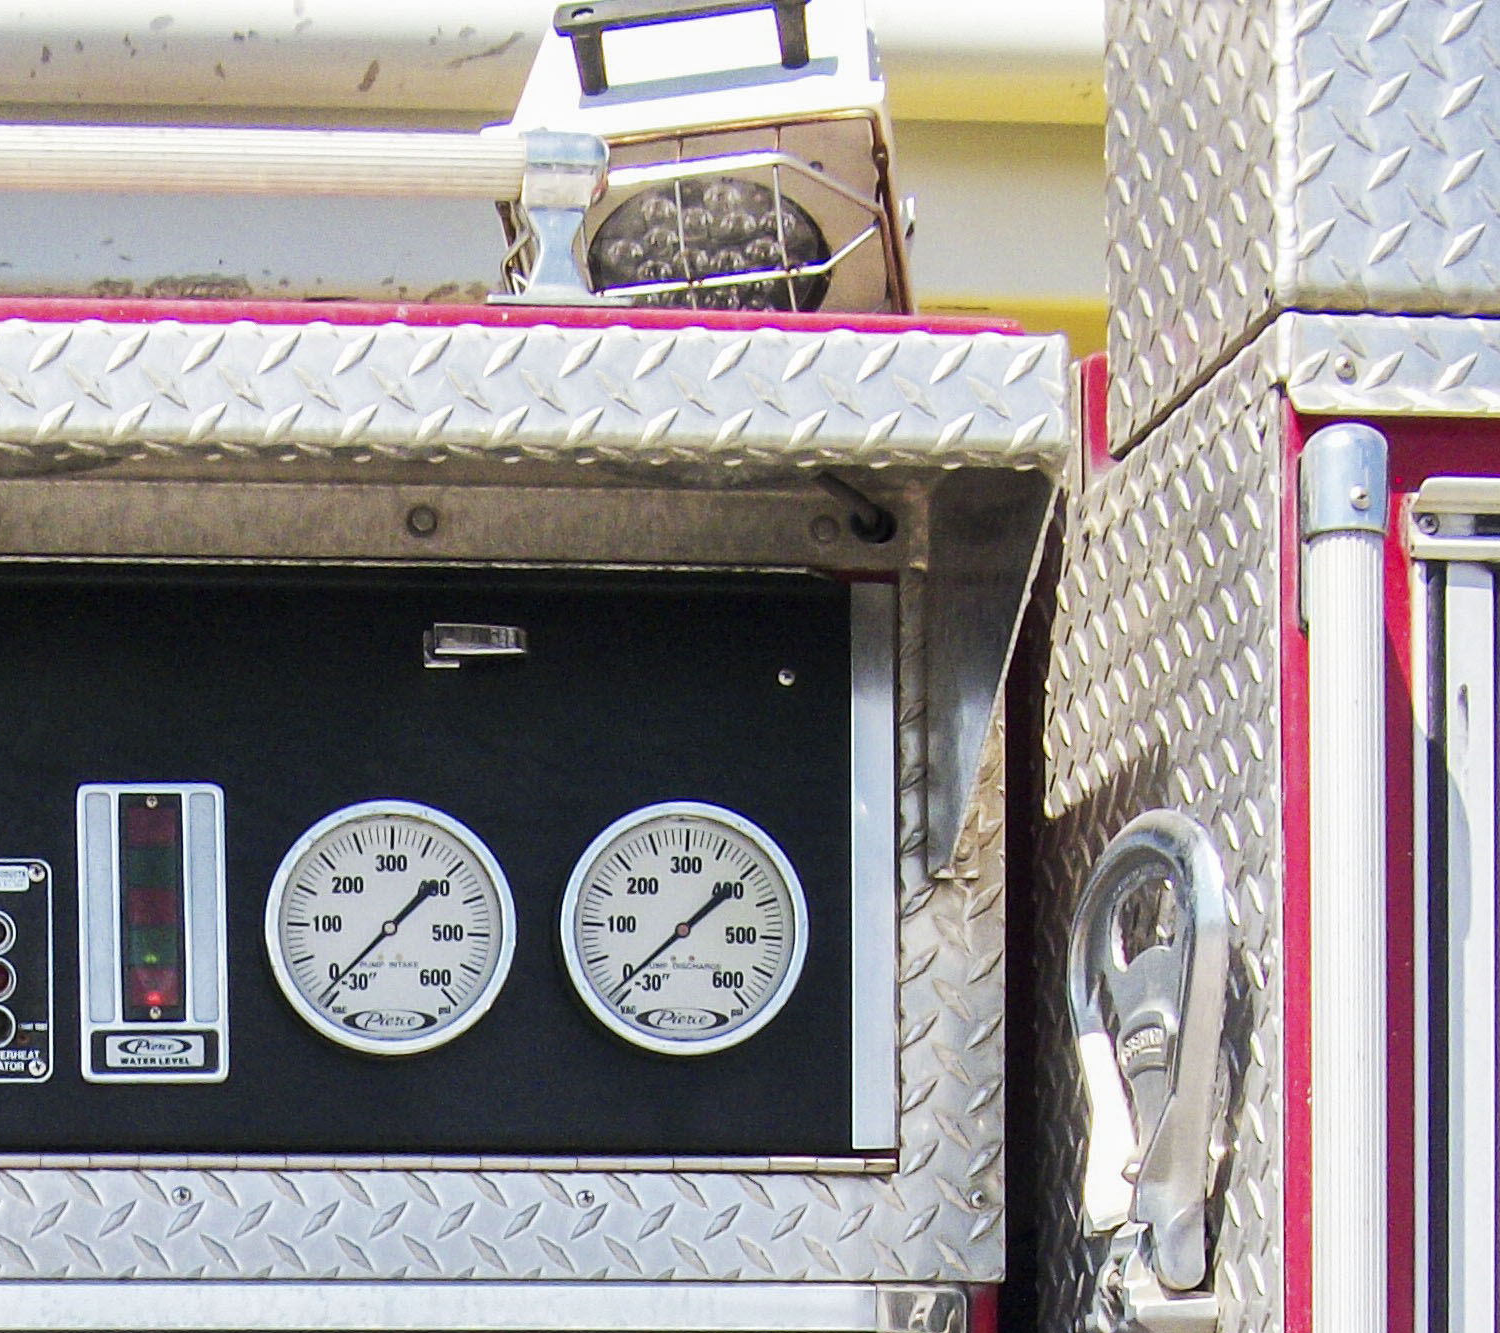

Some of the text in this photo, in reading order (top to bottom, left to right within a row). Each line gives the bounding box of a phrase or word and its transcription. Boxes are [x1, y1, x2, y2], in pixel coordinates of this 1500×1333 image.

[375, 855, 407, 871] 300
[670, 856, 702, 874] 300
[332, 877, 363, 894] 200
[627, 877, 658, 894] 200
[313, 915, 342, 932] 100
[608, 916, 636, 933] 100
[432, 924, 463, 941] 500
[726, 927, 756, 944] 500
[420, 969, 451, 986] 600
[713, 971, 743, 988] 600
[365, 1013, 415, 1028] Pierce
[657, 1010, 707, 1025] Pierce
[120, 1057, 190, 1065] WATER LEVEL
